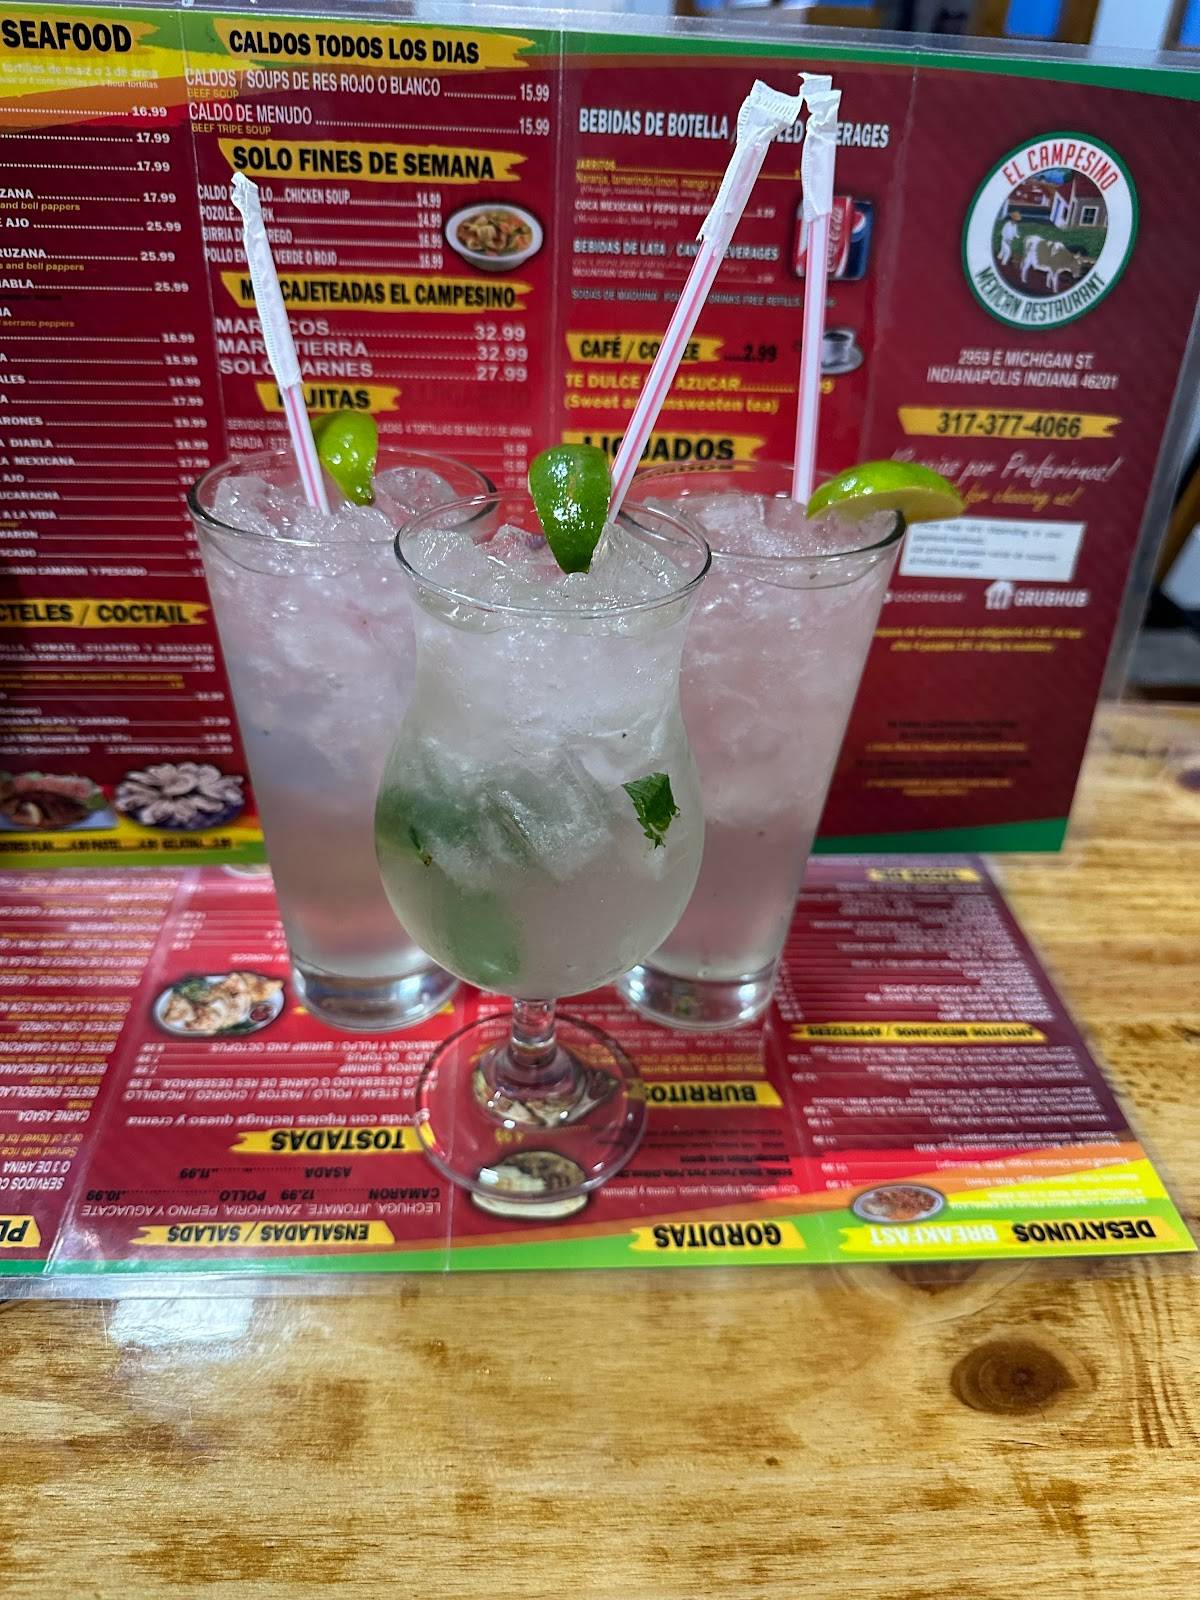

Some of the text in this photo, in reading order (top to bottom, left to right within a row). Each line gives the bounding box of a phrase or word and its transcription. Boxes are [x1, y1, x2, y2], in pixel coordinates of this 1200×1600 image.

[2, 19, 132, 52] SEAFOOD
[229, 30, 480, 64] CALDOS TODOS LOS DIAS
[185, 68, 551, 103] CALDOS SOUPS DE RES ROJO O BLANCO 15.99
[187, 88, 240, 100] BEEF SOUP
[132, 106, 168, 117] 16.99
[189, 103, 550, 137] CALDO DE MENUDO 15.99
[579, 107, 729, 141] BEBIDAS DE BOTELLA
[192, 123, 272, 136] BEEF TRIPE SOUP
[836, 122, 889, 149] ERAGES
[136, 132, 170, 144] 17.99
[136, 161, 171, 172] 17.99
[233, 146, 495, 180] SOLO FINES DE SEMANA
[1002, 143, 1119, 193] EL CAMPESINO
[143, 192, 177, 203] 17.99
[198, 185, 228, 200] CALDO
[284, 187, 325, 204] CHICKEN
[325, 189, 350, 205] SOUP
[21, 201, 39, 211] bell
[200, 204, 235, 221] POZOLE
[6, 217, 182, 233] AJO 25.99
[203, 226, 233, 242] BIRRIA
[140, 251, 176, 263] 25.99
[205, 247, 338, 267] POLLO VERDE ROJO
[573, 239, 780, 261] BEBIDAS DE LATA EVERAGES
[26, 262, 44, 271] bell
[154, 282, 190, 293] 25.99
[240, 278, 517, 308] MCAJETEADAS EL CAMPESINO
[974, 265, 1107, 323] MEXICAN RESTAURANT
[215, 317, 526, 342] MARCOS 32.99
[475, 346, 528, 362] 32.99
[580, 336, 621, 359] CAFÉ
[638, 342, 701, 362] COEE
[992, 351, 1003, 367] E
[1005, 351, 1072, 368] MICHIGAN
[303, 361, 374, 378] ARNES
[475, 367, 528, 382] 27.99
[926, 368, 1120, 389] INDIANAPOLIS INDIANA 46201
[566, 373, 741, 393] TE DULCE AZUCAR
[278, 387, 372, 410] JITAS
[937, 411, 1083, 438] 317-377-4066
[9, 438, 54, 448] DIABLA
[584, 436, 736, 461] IADOS
[14, 456, 76, 467] MEXICANA
[1013, 589, 1088, 608] GRUBHUB
[96, 603, 191, 624] COCTAIL
[645, 1085, 756, 1102] BURRITO
[16, 1109, 91, 1122] CARNE ASADA
[126, 1115, 173, 1126] crema
[189, 1114, 234, 1125] queso
[238, 1113, 294, 1125] lechuga
[299, 1112, 347, 1125] frijoles
[351, 1114, 378, 1123] con
[270, 1129, 405, 1151] TOSTADAS
[304, 1166, 352, 1179] ASADA
[10, 1176, 65, 1190] SERVIDOS
[219, 1189, 268, 1202] POLLO
[280, 1188, 316, 1201] 12.99
[368, 1187, 440, 1200] CAMARON
[80, 1204, 154, 1216] AGUACATE
[154, 1204, 165, 1216] Y
[166, 1203, 219, 1216] PEPINO
[167, 1222, 370, 1242] ENSALADAS SALADS
[652, 1221, 782, 1250] GORDITAS
[868, 1219, 1156, 1247] DESAYUNOS BREAKFAST
